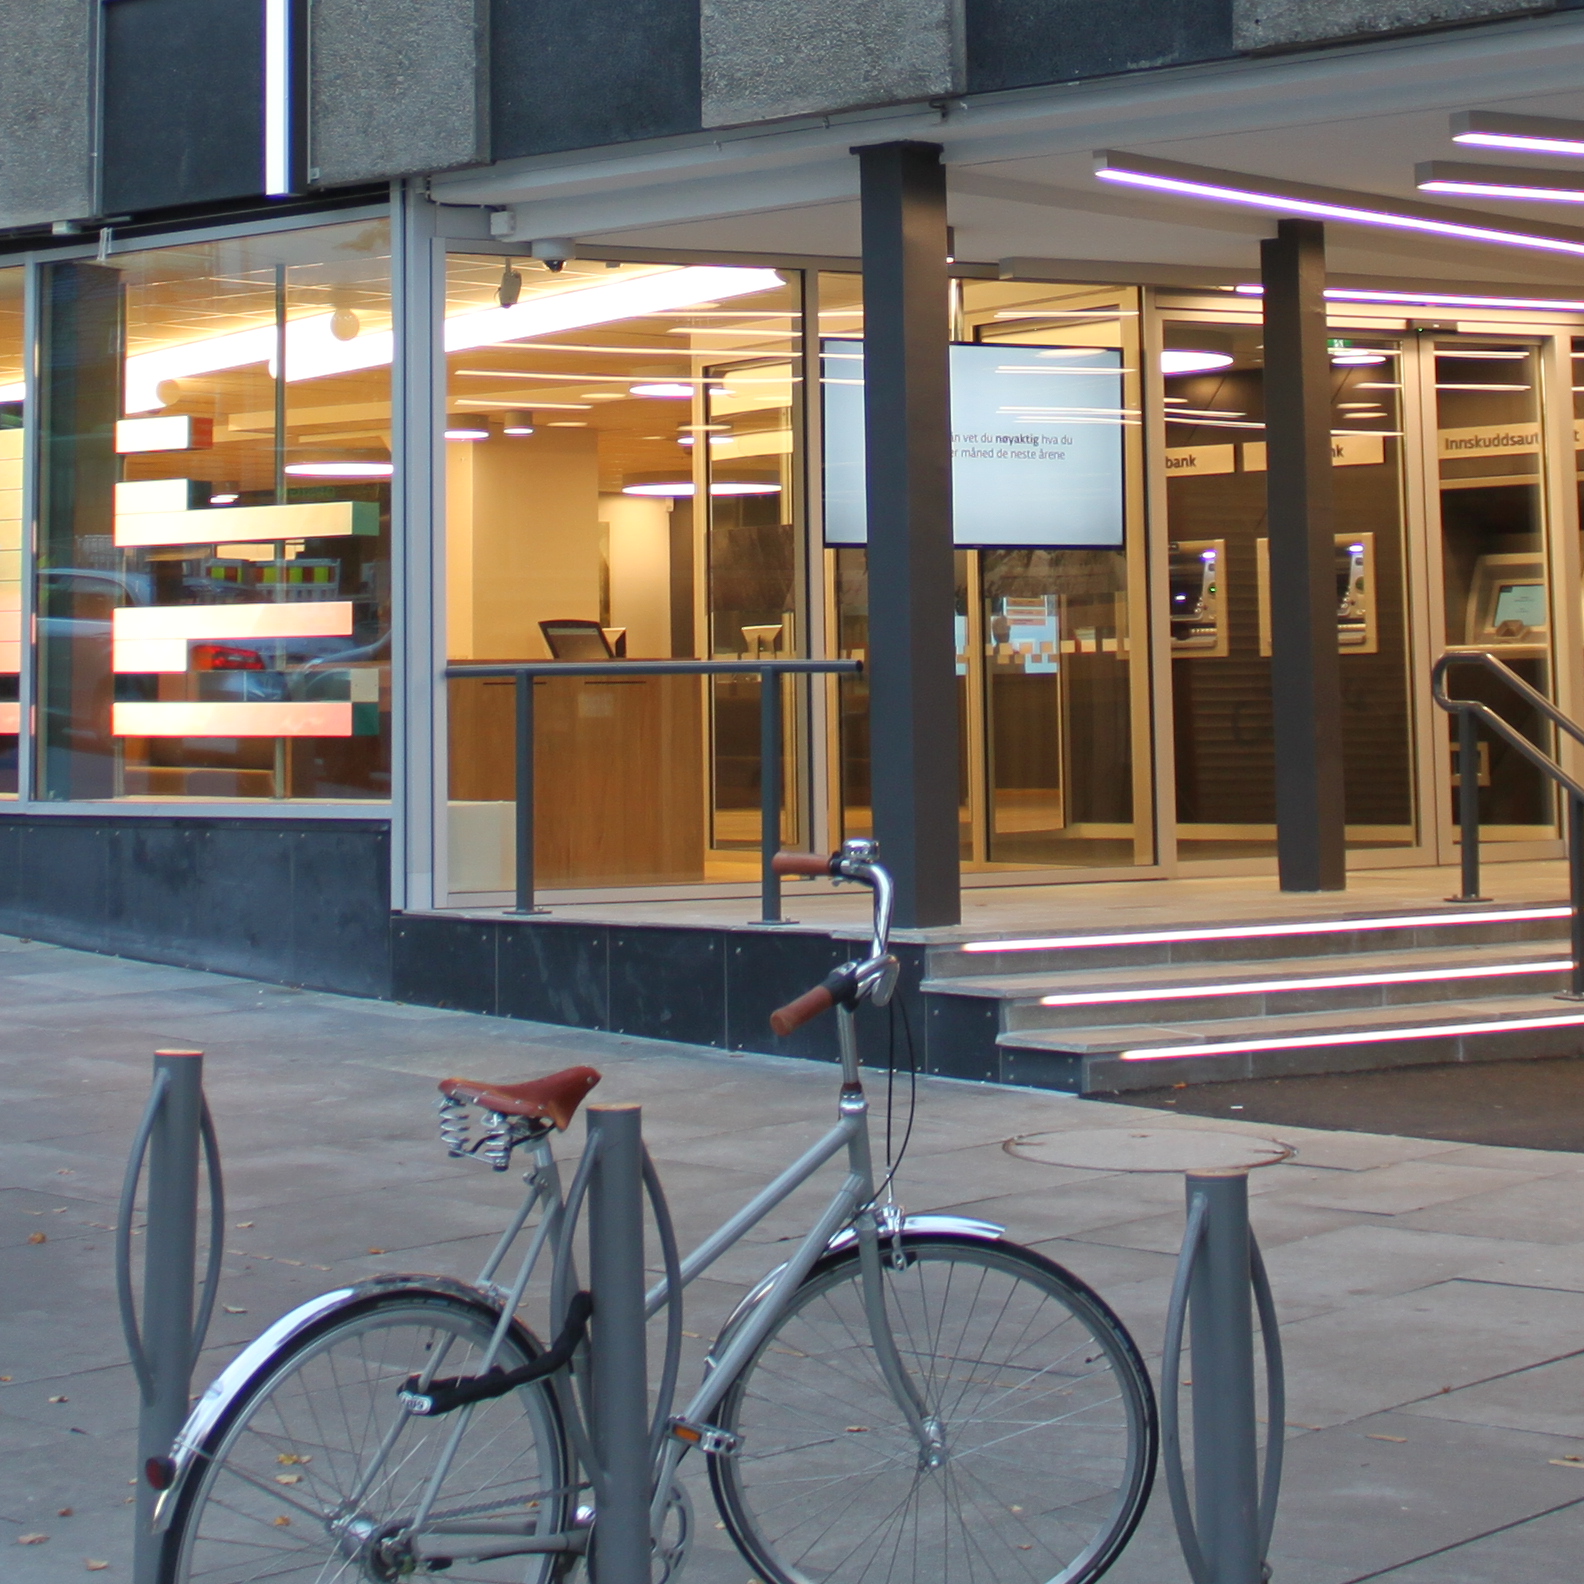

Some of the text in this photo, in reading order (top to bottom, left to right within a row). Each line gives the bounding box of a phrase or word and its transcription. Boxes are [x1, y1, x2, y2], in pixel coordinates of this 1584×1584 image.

[963, 434, 978, 443] vet
[981, 433, 993, 443] du
[996, 433, 1039, 447] nøyaktig
[1041, 434, 1059, 445] hva
[1061, 434, 1073, 445] du
[961, 447, 994, 458] måned
[996, 448, 1008, 459] de
[1011, 449, 1037, 460] neste
[1039, 448, 1066, 460] årene
